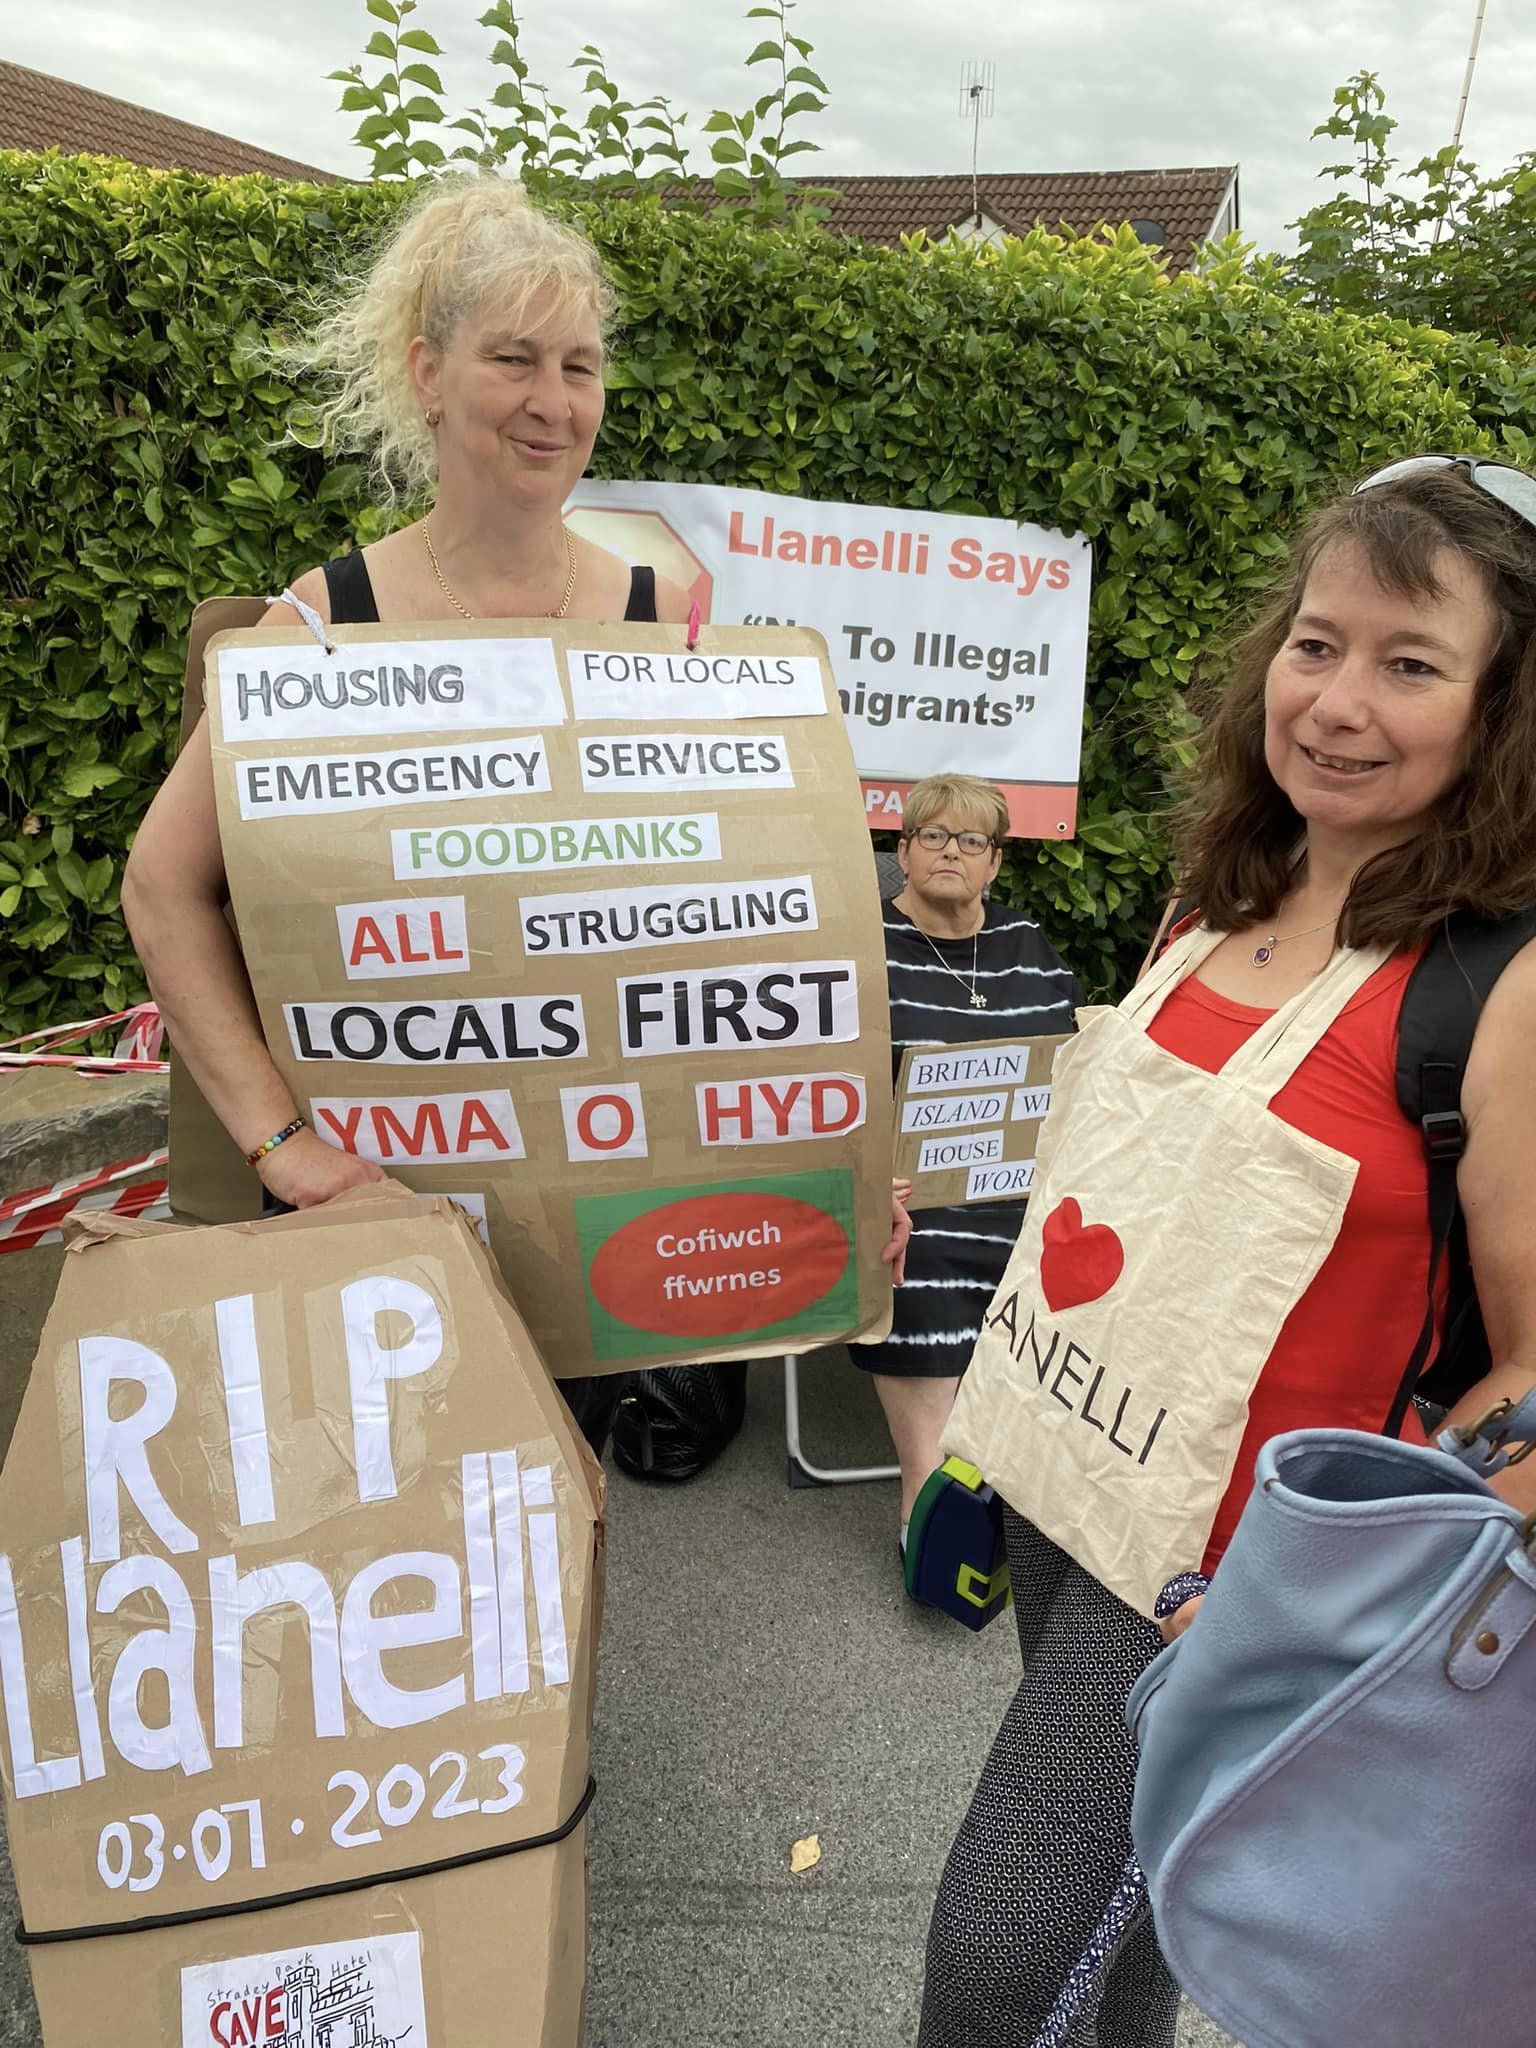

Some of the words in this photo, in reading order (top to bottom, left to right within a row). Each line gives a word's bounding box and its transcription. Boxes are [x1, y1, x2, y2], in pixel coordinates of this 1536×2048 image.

[729, 511, 929, 575] Llanelli
[948, 538, 1071, 596] Says
[584, 654, 656, 683] FOR
[667, 658, 795, 686] LOCALS
[842, 625, 895, 662] To
[913, 632, 1050, 681] Illegal
[238, 664, 464, 721] HOUSING
[248, 751, 540, 803] EMERGENCY
[586, 742, 781, 777] SERVICES
[865, 789, 912, 814] PA
[411, 821, 703, 869] FOODBANKS
[350, 911, 463, 967] ALL
[525, 888, 809, 951] STRUGGLING
[292, 1000, 580, 1060] LOCALS
[626, 971, 850, 1049] FIRST
[916, 1055, 1021, 1085] BRITAIN
[317, 1099, 510, 1158] YMA
[577, 1095, 634, 1150] O
[705, 1079, 861, 1142] HYD
[912, 1099, 1000, 1127] ISLAND
[923, 1140, 999, 1167] HOUSE
[656, 1219, 782, 1258] Cofiwch
[663, 1266, 782, 1300] ffwrnes
[984, 1290, 1167, 1465] ANELLI
[0, 1450, 570, 1799] Llanelli
[207, 1980, 270, 2009] Stradey
[275, 1952, 313, 1980] Park
[331, 1950, 373, 1977] Hotel
[209, 1985, 285, 2048] SAVE
